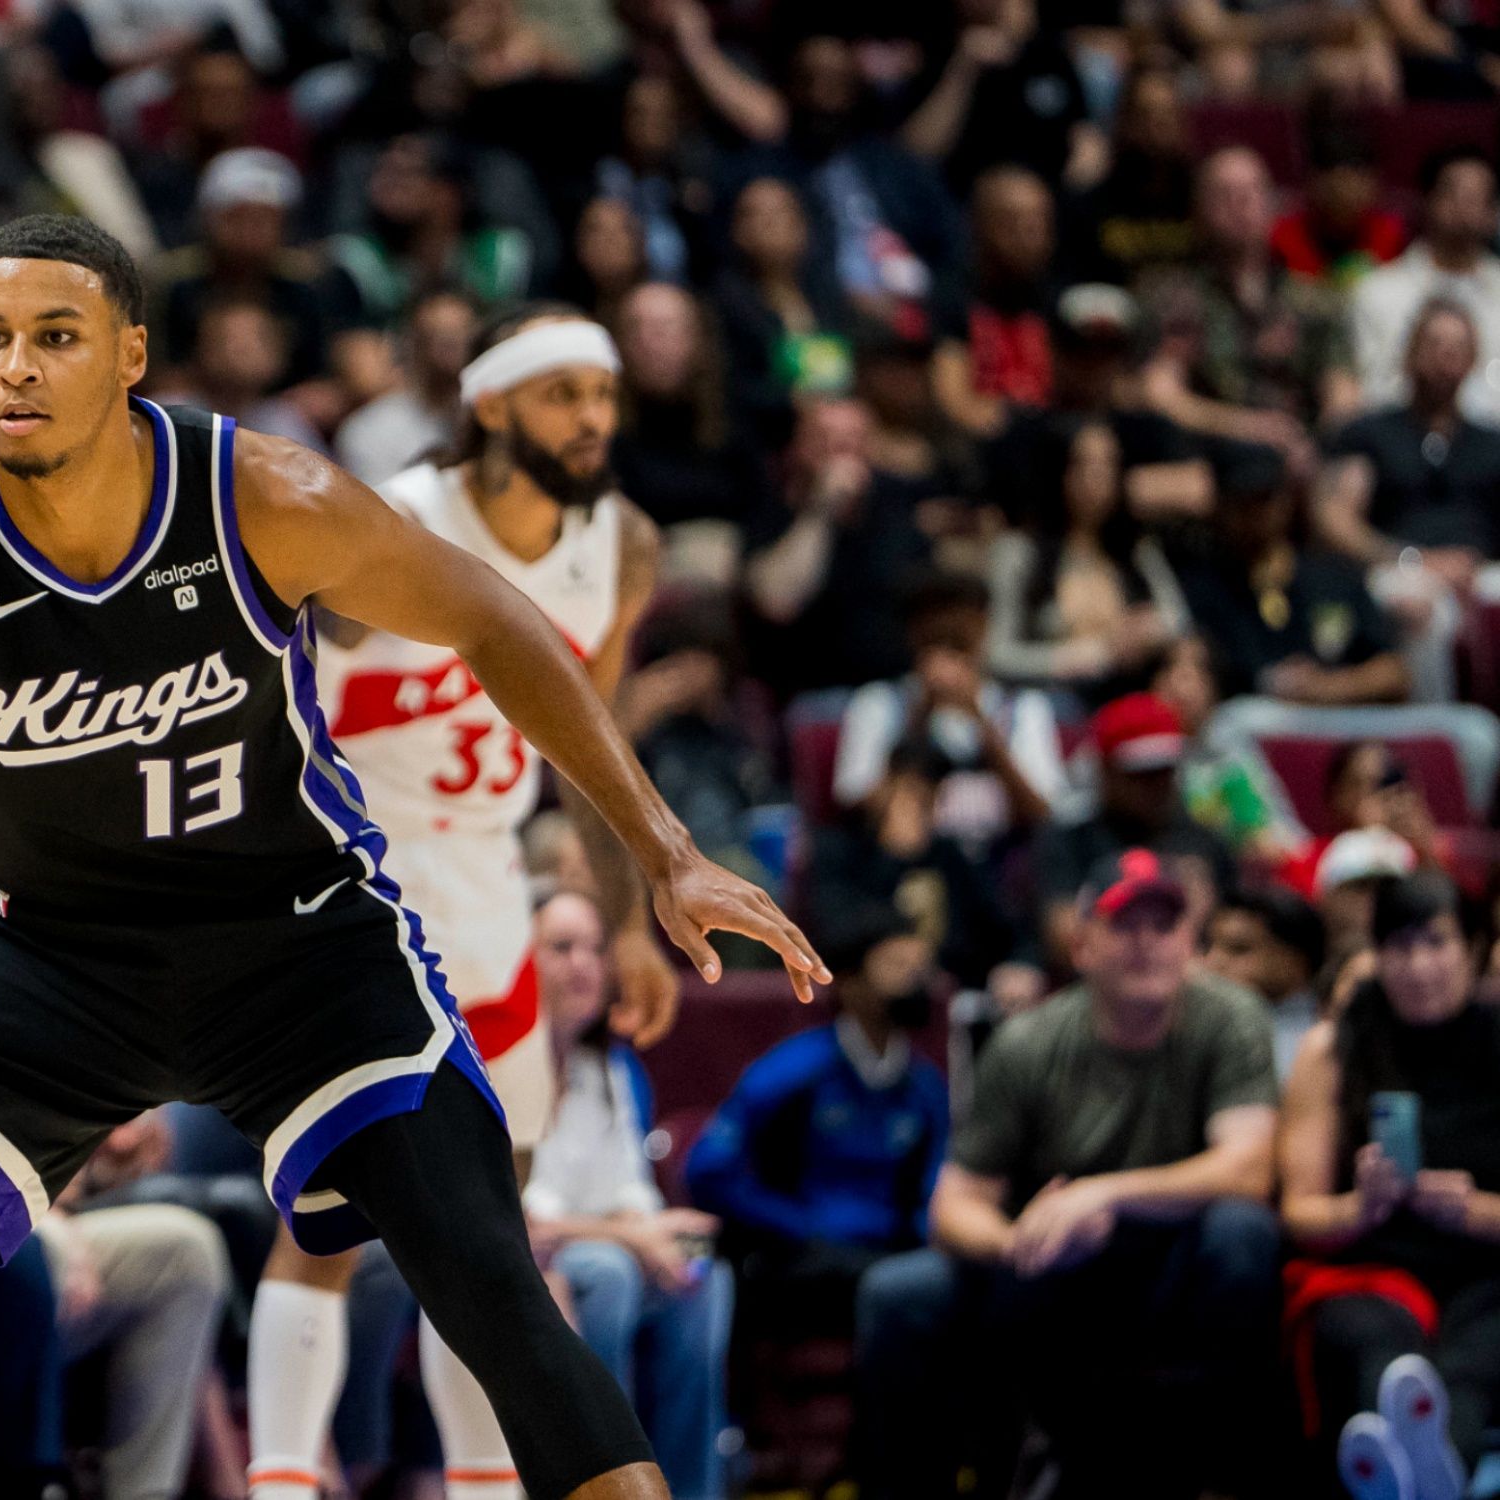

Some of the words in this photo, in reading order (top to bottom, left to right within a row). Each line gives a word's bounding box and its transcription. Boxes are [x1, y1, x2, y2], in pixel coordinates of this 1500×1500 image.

[144, 553, 219, 589] dialpad
[138, 740, 244, 838] 13
[432, 721, 526, 795] 33
